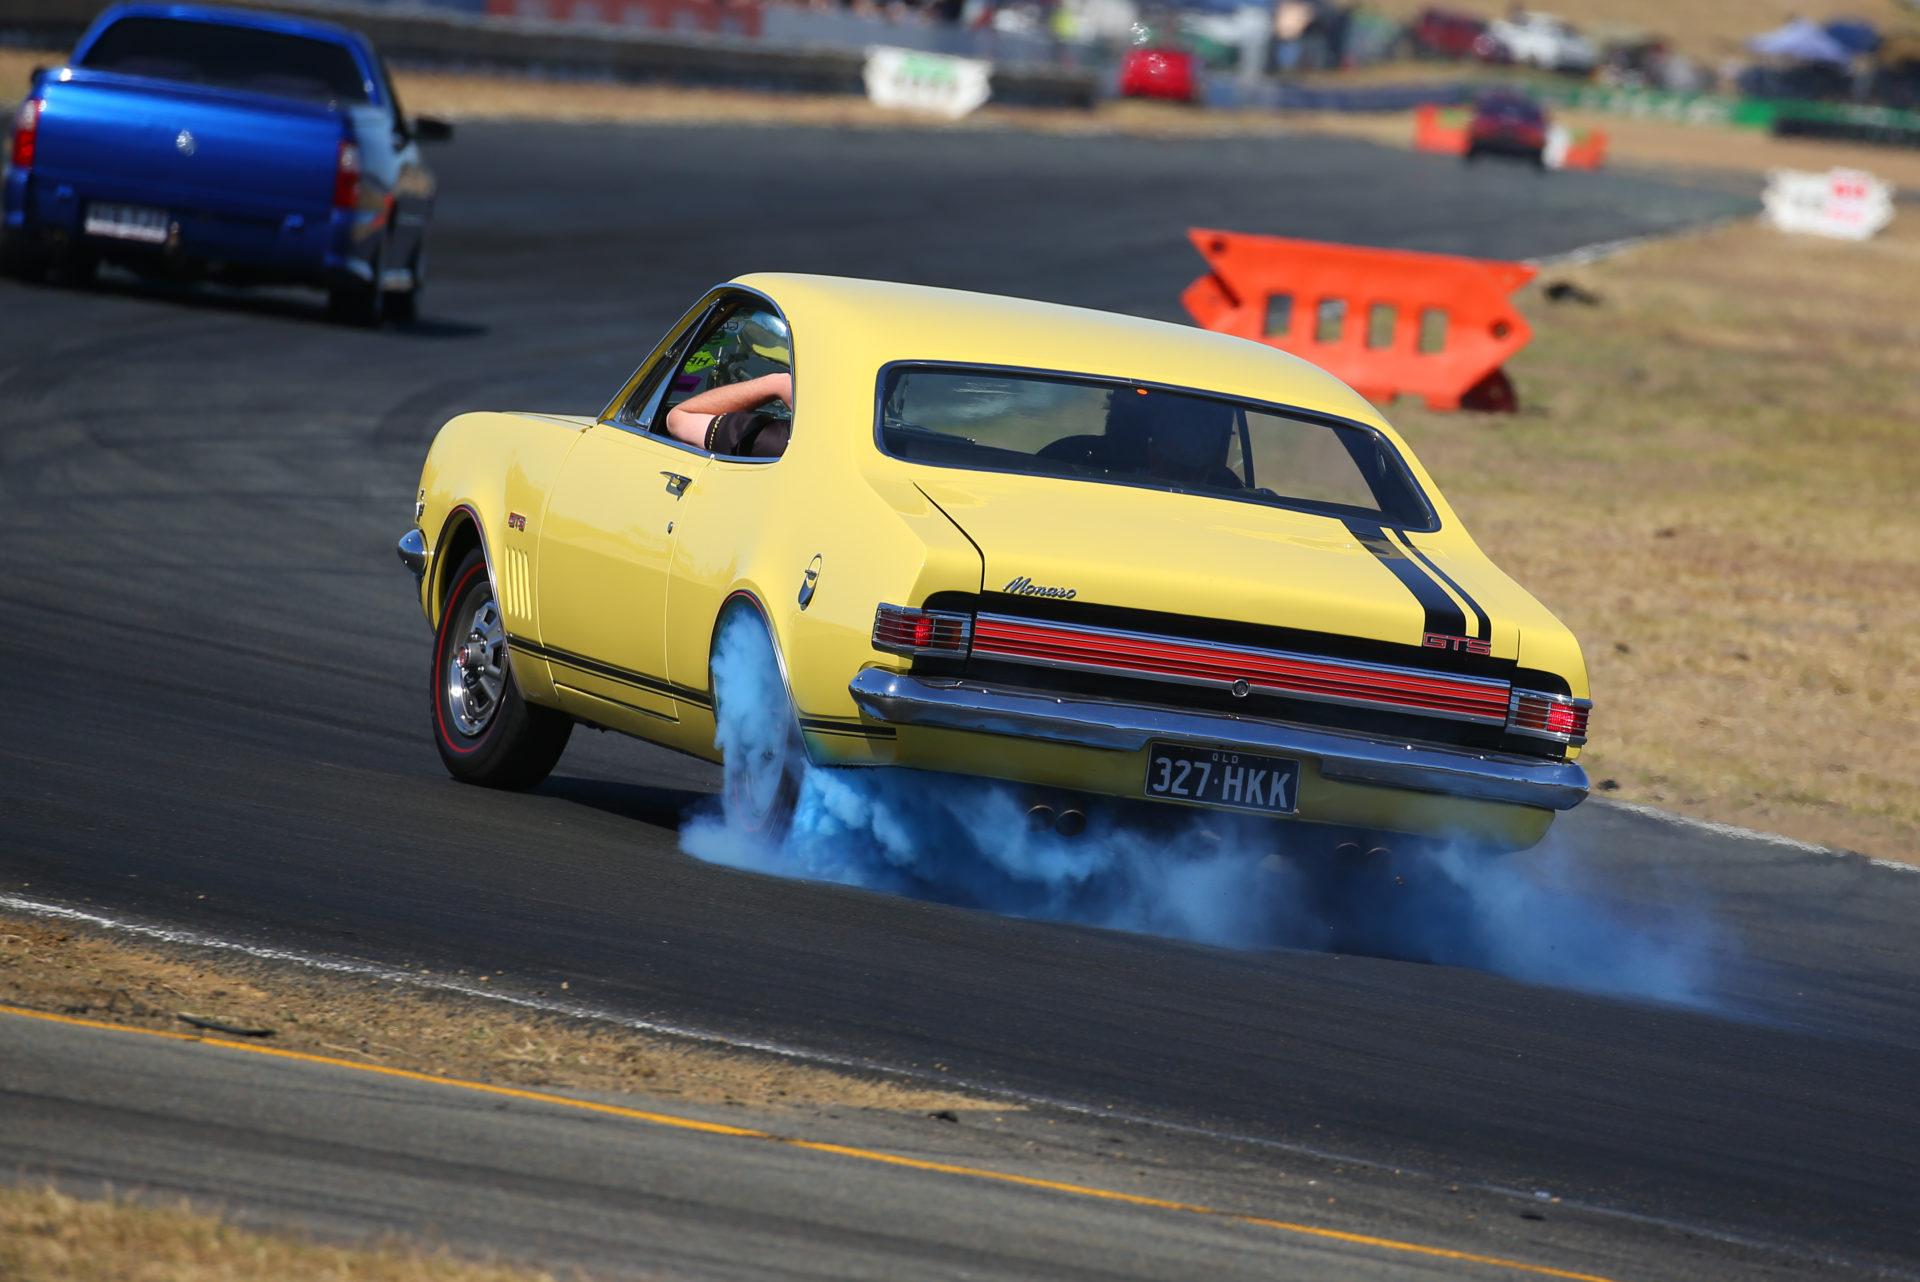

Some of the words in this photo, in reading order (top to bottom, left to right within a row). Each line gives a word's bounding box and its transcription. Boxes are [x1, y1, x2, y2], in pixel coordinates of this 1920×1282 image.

[1002, 576, 1077, 599] Monaro
[1423, 632, 1491, 655] GTS
[1212, 752, 1239, 764] QLD
